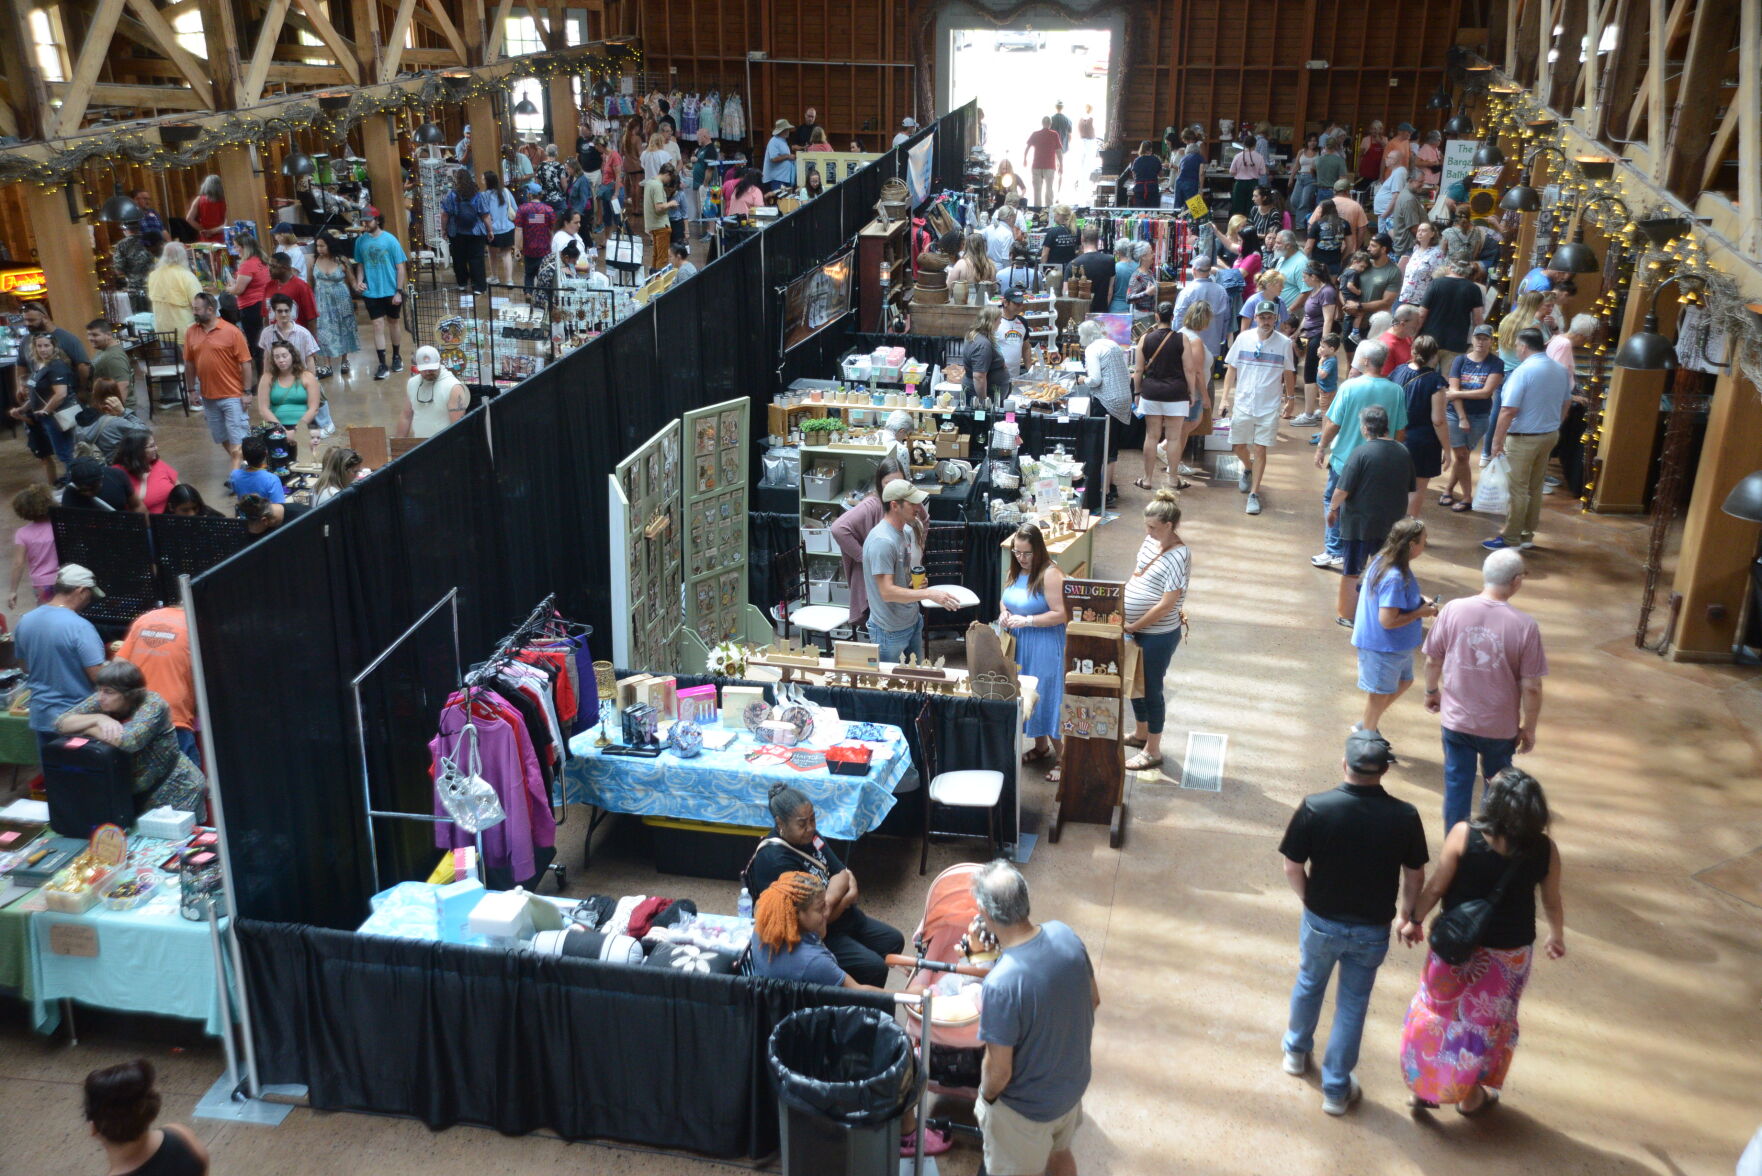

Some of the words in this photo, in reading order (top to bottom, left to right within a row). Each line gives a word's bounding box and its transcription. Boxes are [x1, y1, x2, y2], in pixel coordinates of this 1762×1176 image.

[1458, 144, 1473, 153] The
[1447, 157, 1473, 168] Barga
[1064, 584, 1120, 598] SWIDGETZ
